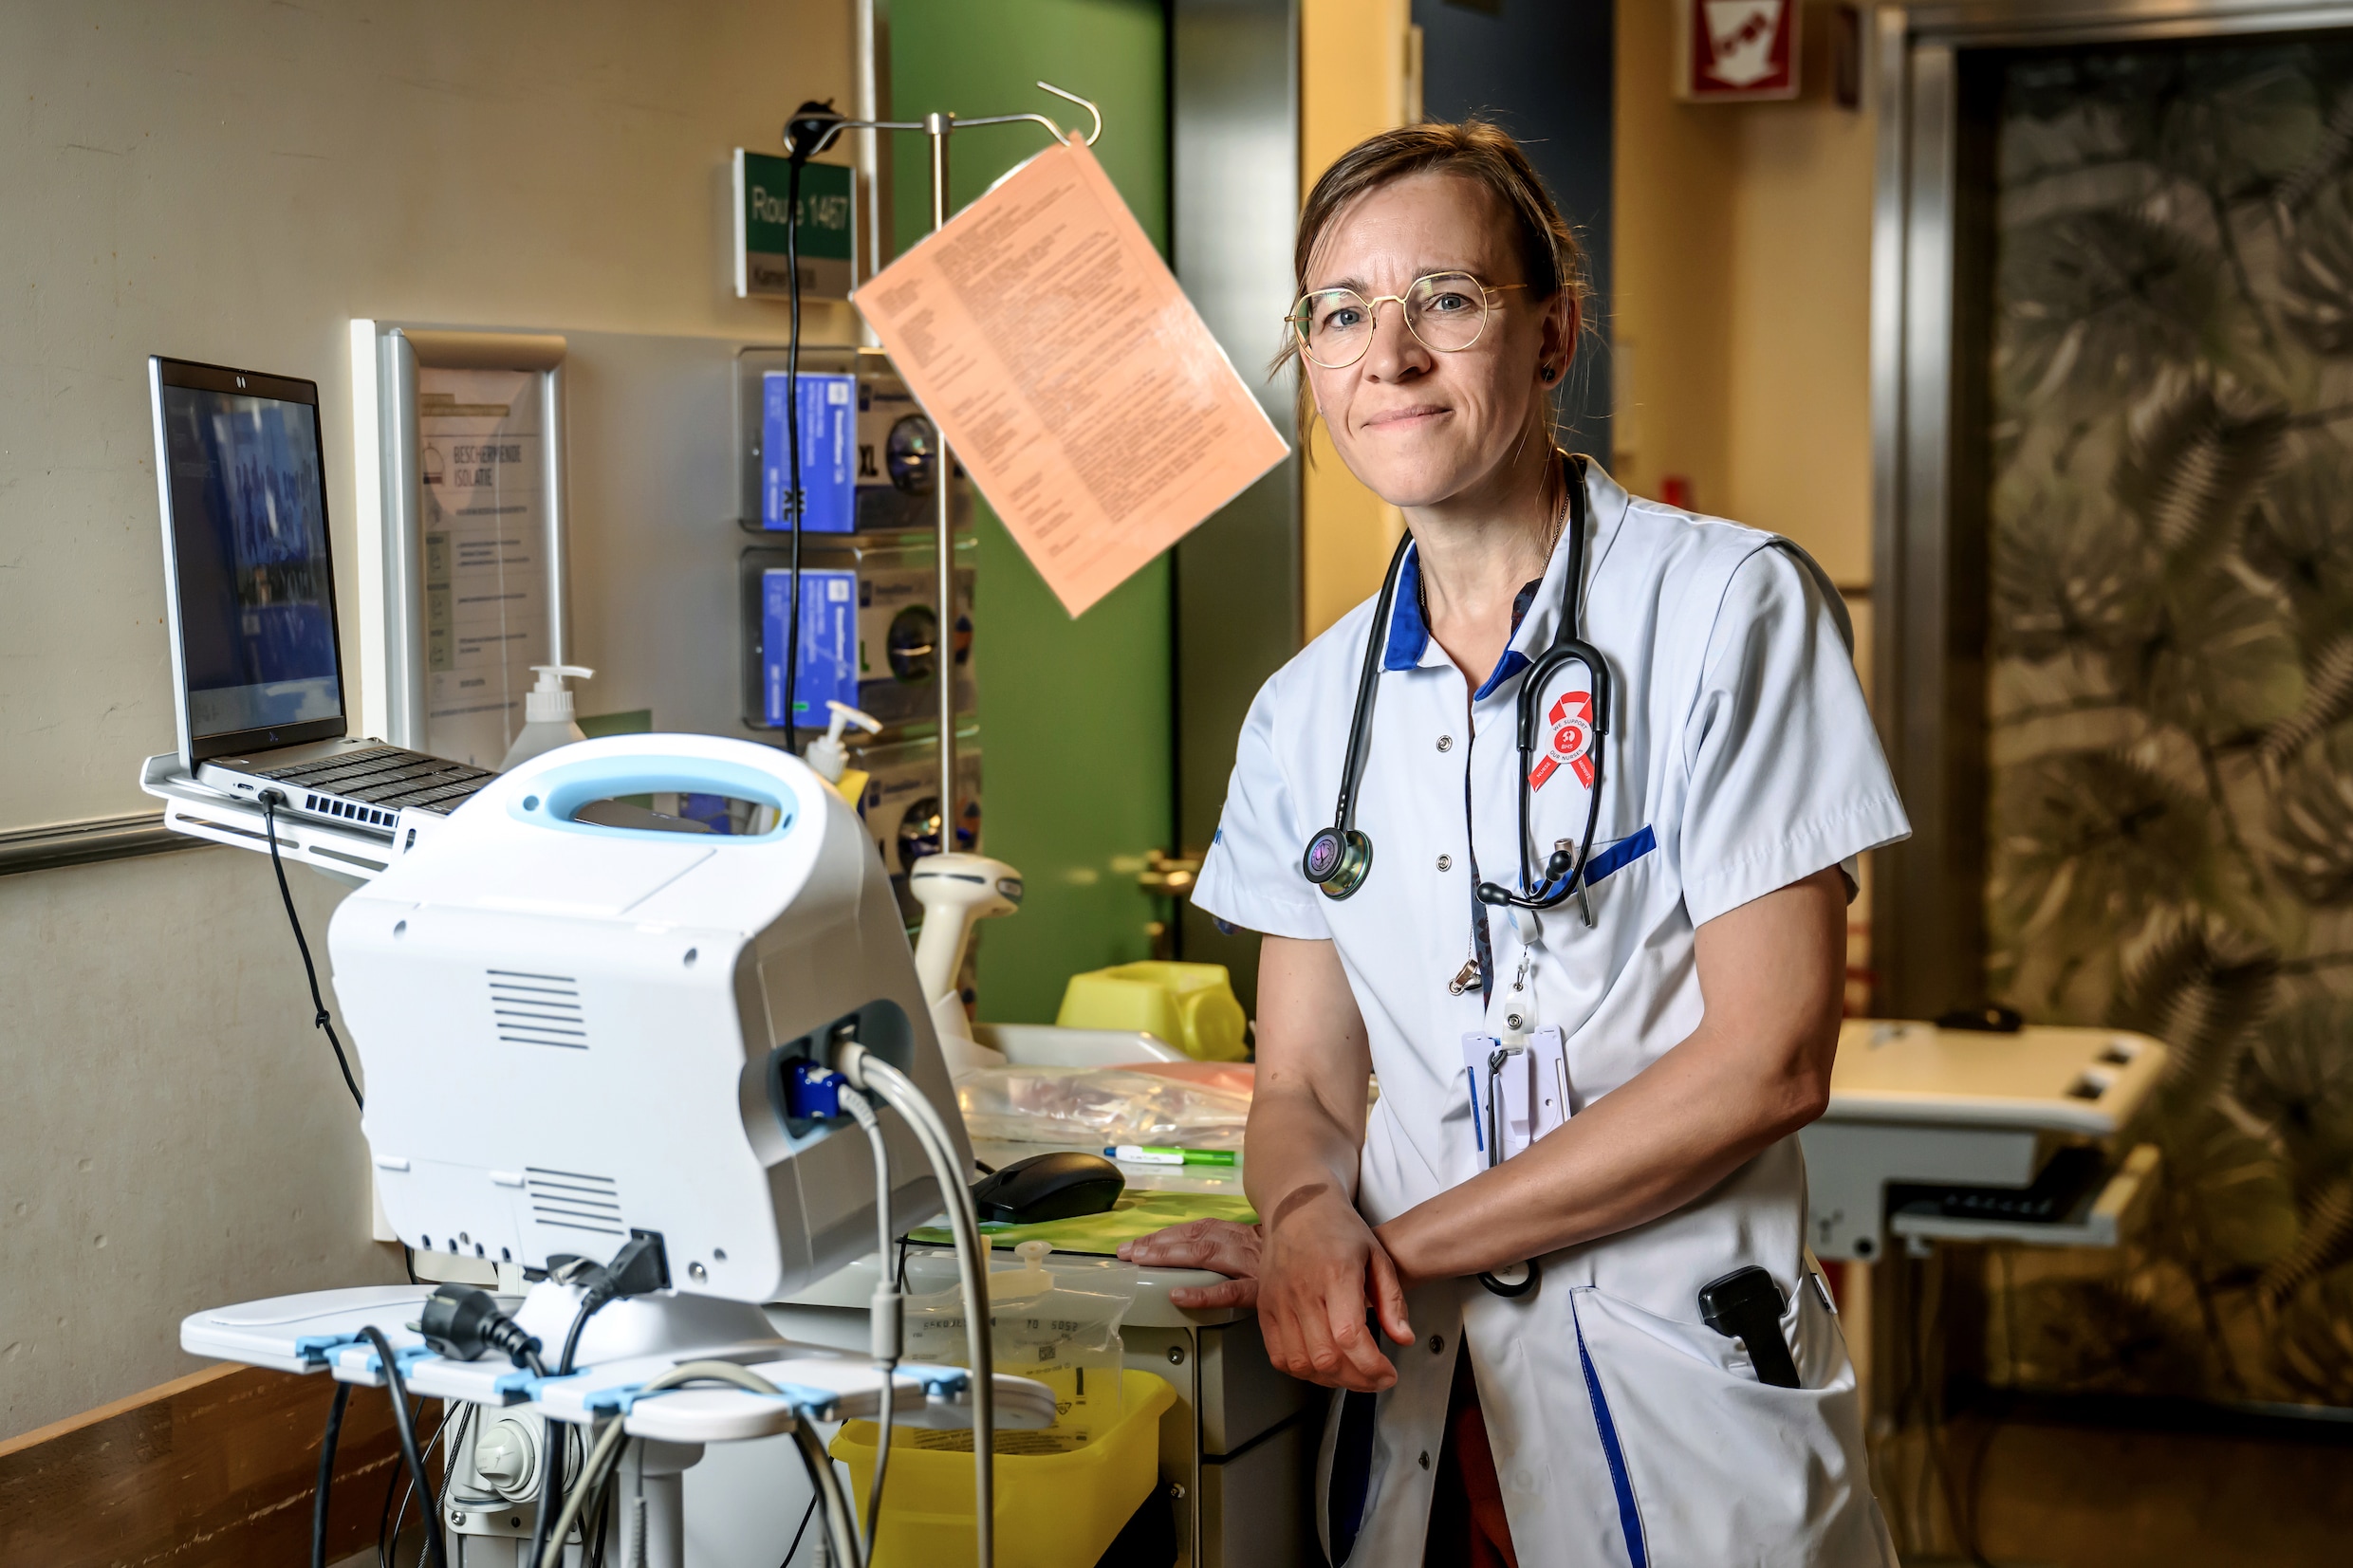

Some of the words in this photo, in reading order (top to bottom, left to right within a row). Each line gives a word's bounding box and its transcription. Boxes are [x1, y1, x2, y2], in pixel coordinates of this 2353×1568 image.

[751, 185, 805, 227] Roue
[454, 468, 492, 488] ISOLATIE
[1564, 719, 1587, 729] SUPPORT
[1549, 750, 1560, 759] OUR
[1562, 749, 1584, 761] NURSES
[1537, 762, 1551, 778] NURSE
